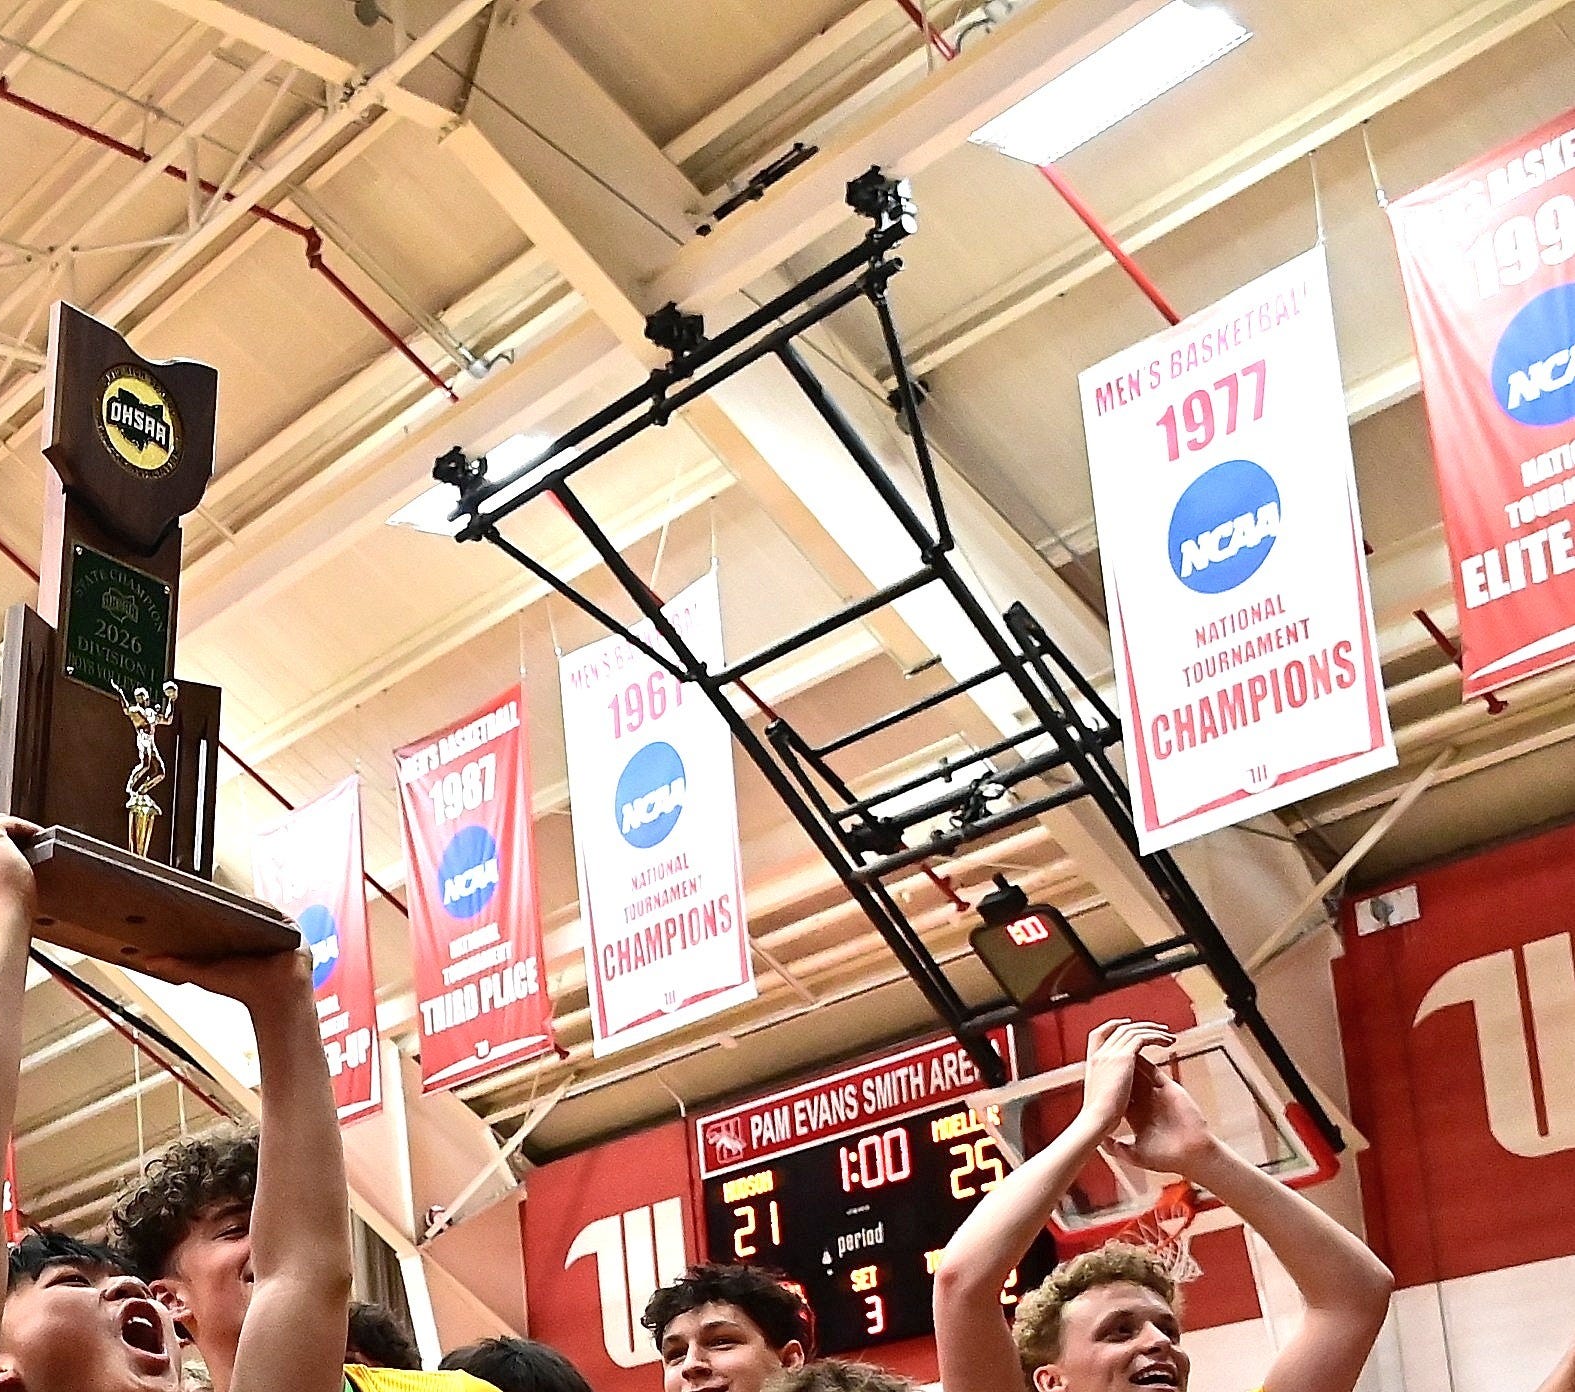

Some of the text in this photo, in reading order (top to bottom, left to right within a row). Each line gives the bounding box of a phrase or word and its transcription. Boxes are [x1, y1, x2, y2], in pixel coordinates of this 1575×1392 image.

[1095, 281, 1307, 417] MEN'S BASKETBAL
[1507, 343, 1575, 410] NC
[110, 401, 167, 445] OHSAA
[1155, 358, 1267, 462] 1977
[1180, 501, 1280, 578] NCAA
[1460, 518, 1575, 611] ELITE
[95, 618, 142, 655] 2026
[1182, 617, 1310, 687] TOURNAMENT
[1195, 594, 1286, 648] NATIONAL
[1151, 640, 1356, 760] CHAMPIONS
[428, 752, 497, 826] 1987
[621, 776, 686, 834] NCAA
[443, 858, 499, 905] NCAA
[624, 874, 703, 925] TOURNAMENT
[631, 853, 690, 891] NATIONAL
[603, 894, 732, 981] CHAMPIONS
[419, 957, 539, 1036] THIRD PLACE
[750, 1105, 792, 1150] PAM
[794, 1086, 859, 1137] EVANS
[861, 1067, 925, 1114] SMITH
[839, 1127, 911, 1193] 1:00
[949, 1136, 1005, 1199] 25
[733, 1200, 781, 1257] 21
[837, 1221, 884, 1258] period
[850, 1265, 878, 1292] SET
[864, 1295, 884, 1335] 3
